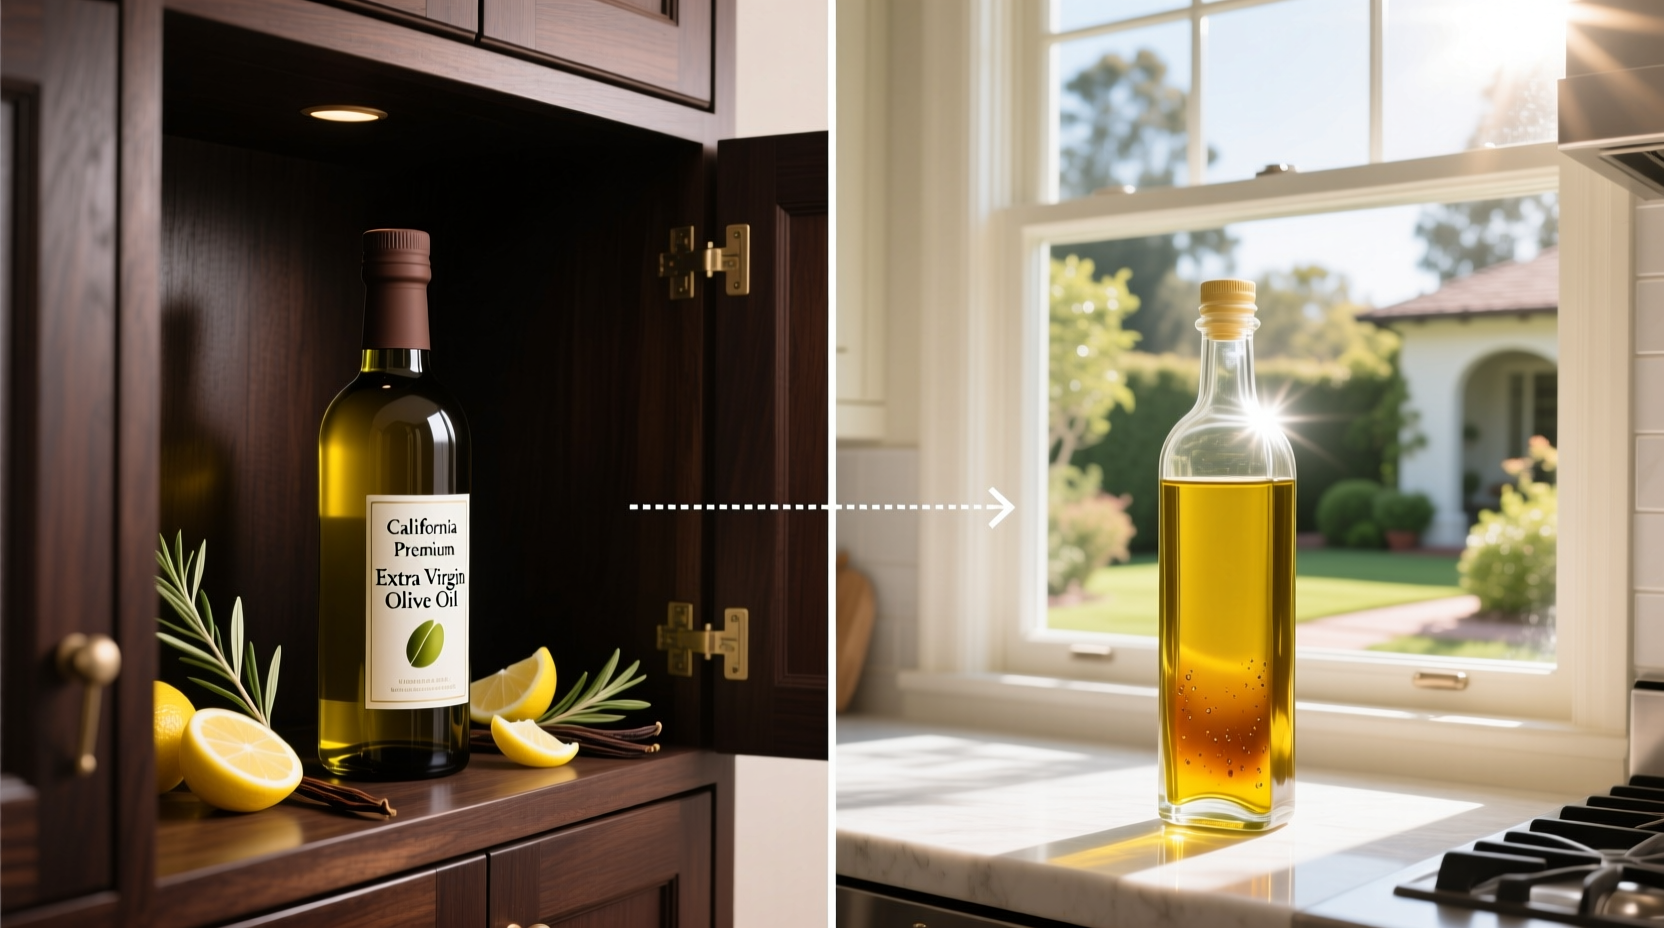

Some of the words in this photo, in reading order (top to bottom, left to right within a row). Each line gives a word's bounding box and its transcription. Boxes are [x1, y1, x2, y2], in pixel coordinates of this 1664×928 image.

[386, 517, 457, 535] California
[394, 541, 455, 557] Premium
[375, 568, 420, 587] Extra
[424, 568, 465, 590] Virgin
[385, 591, 431, 609] Olive
[435, 590, 458, 608] Oil
